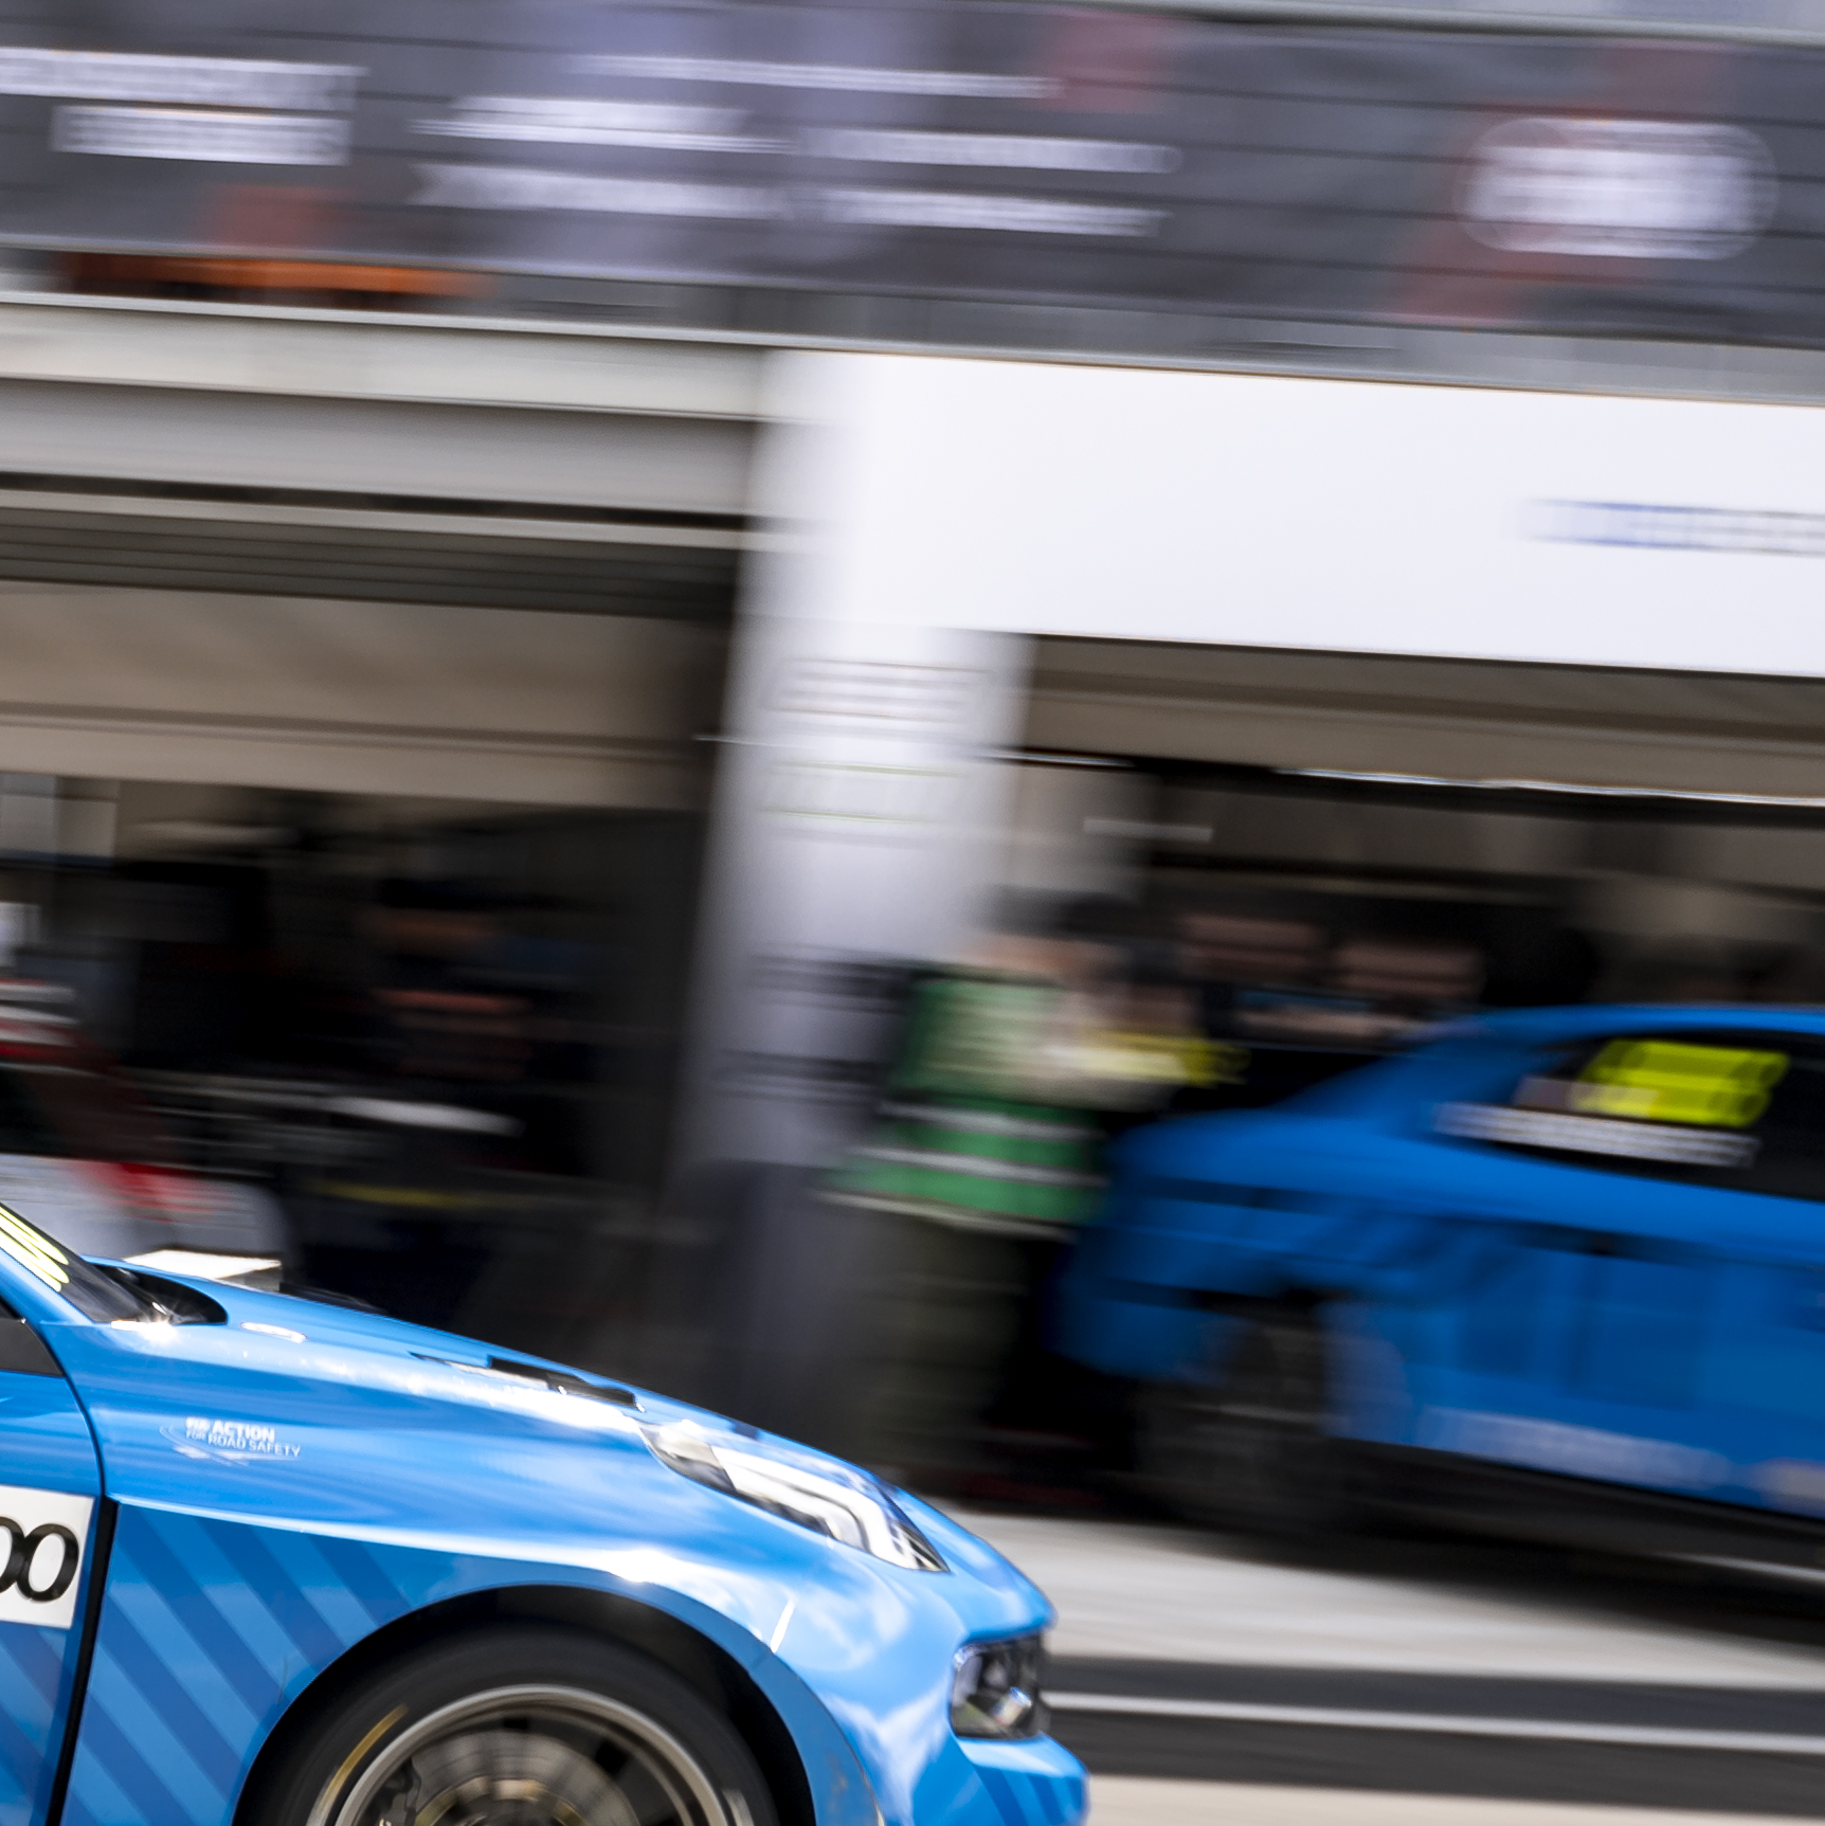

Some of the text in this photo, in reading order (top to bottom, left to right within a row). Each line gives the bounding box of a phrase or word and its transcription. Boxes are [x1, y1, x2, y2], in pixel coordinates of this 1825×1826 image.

[212, 1419, 275, 1443] ACTION
[208, 1433, 246, 1449] ROAD
[249, 1441, 301, 1458] SAFETY
